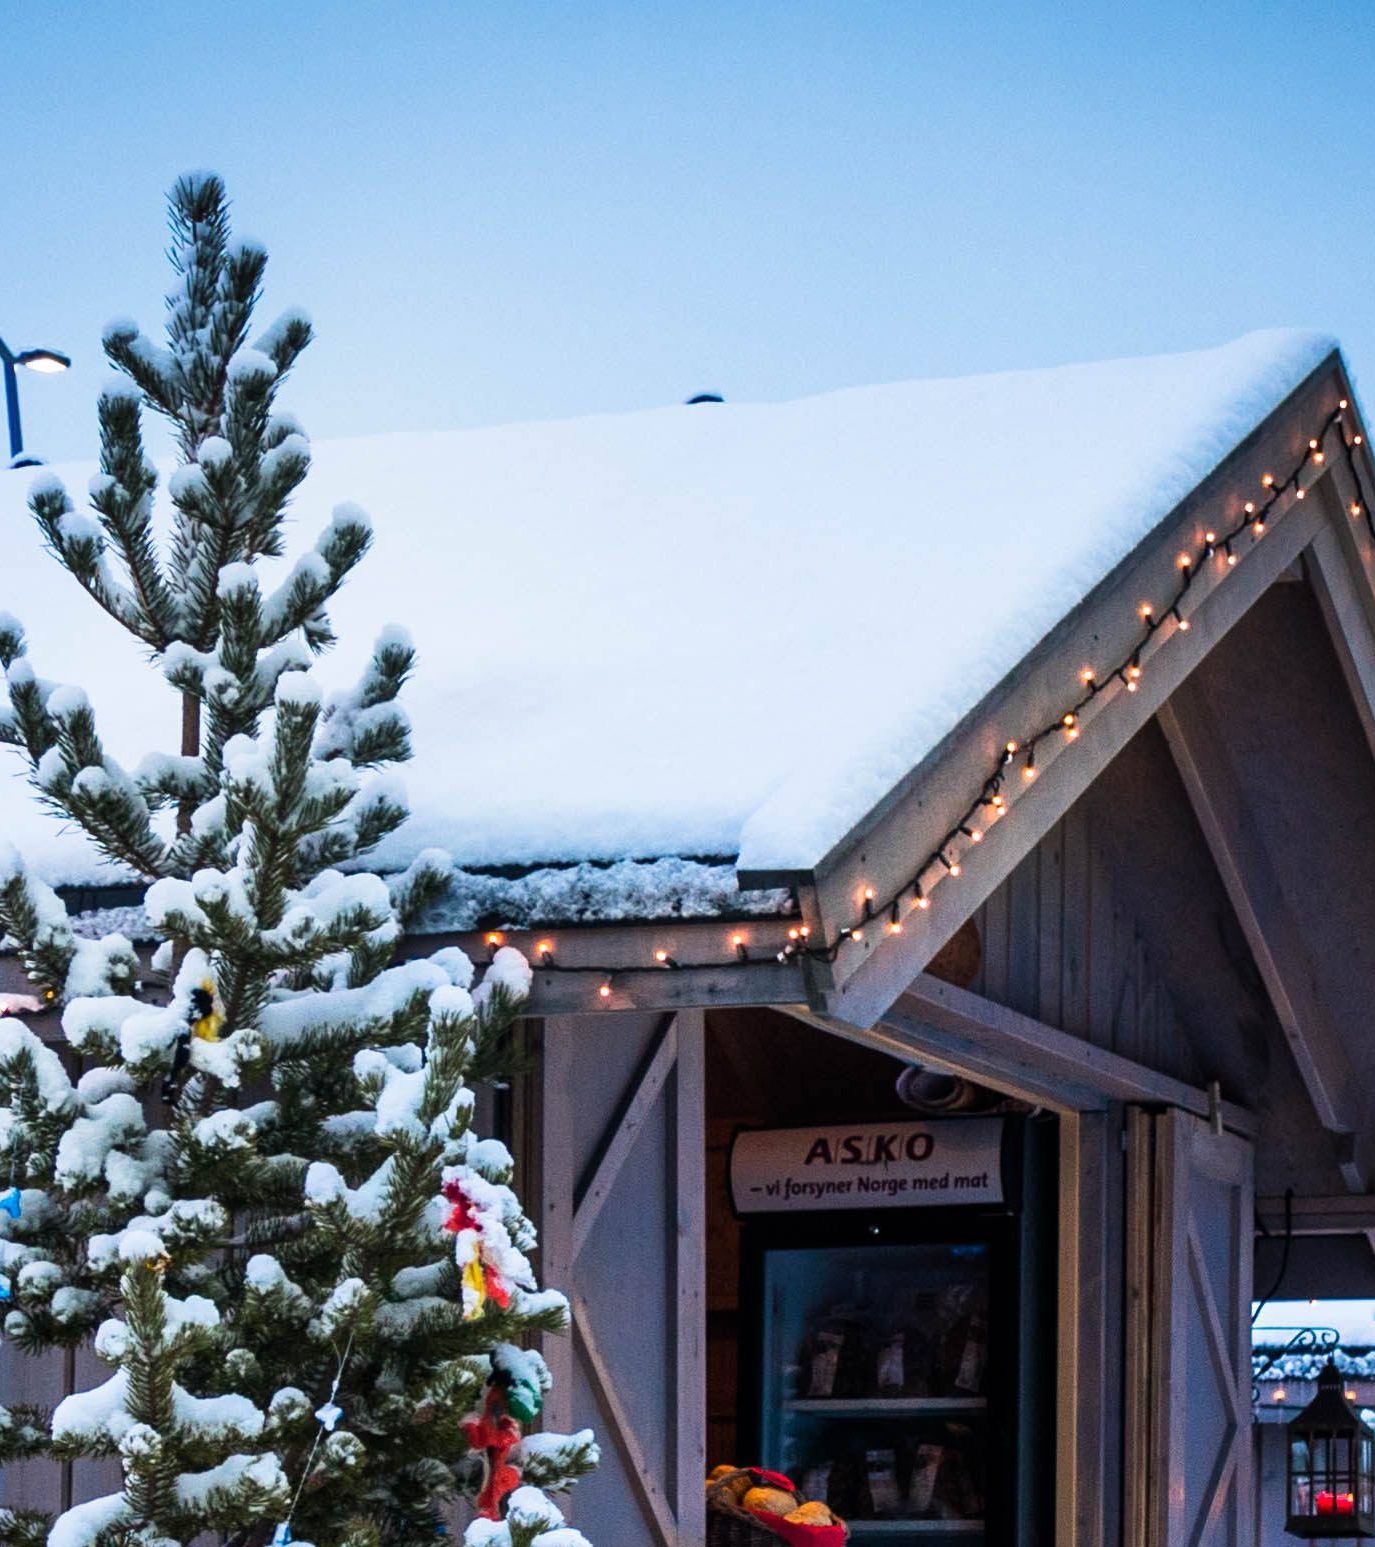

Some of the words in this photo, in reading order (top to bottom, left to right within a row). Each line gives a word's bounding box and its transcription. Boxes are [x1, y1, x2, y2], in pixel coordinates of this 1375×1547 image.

[804, 1132, 936, 1165] ASKO
[765, 1178, 780, 1197] vi
[783, 1175, 853, 1200] forsyner
[857, 1174, 908, 1197] Norge
[913, 1172, 950, 1192] med
[954, 1173, 988, 1190] mat
